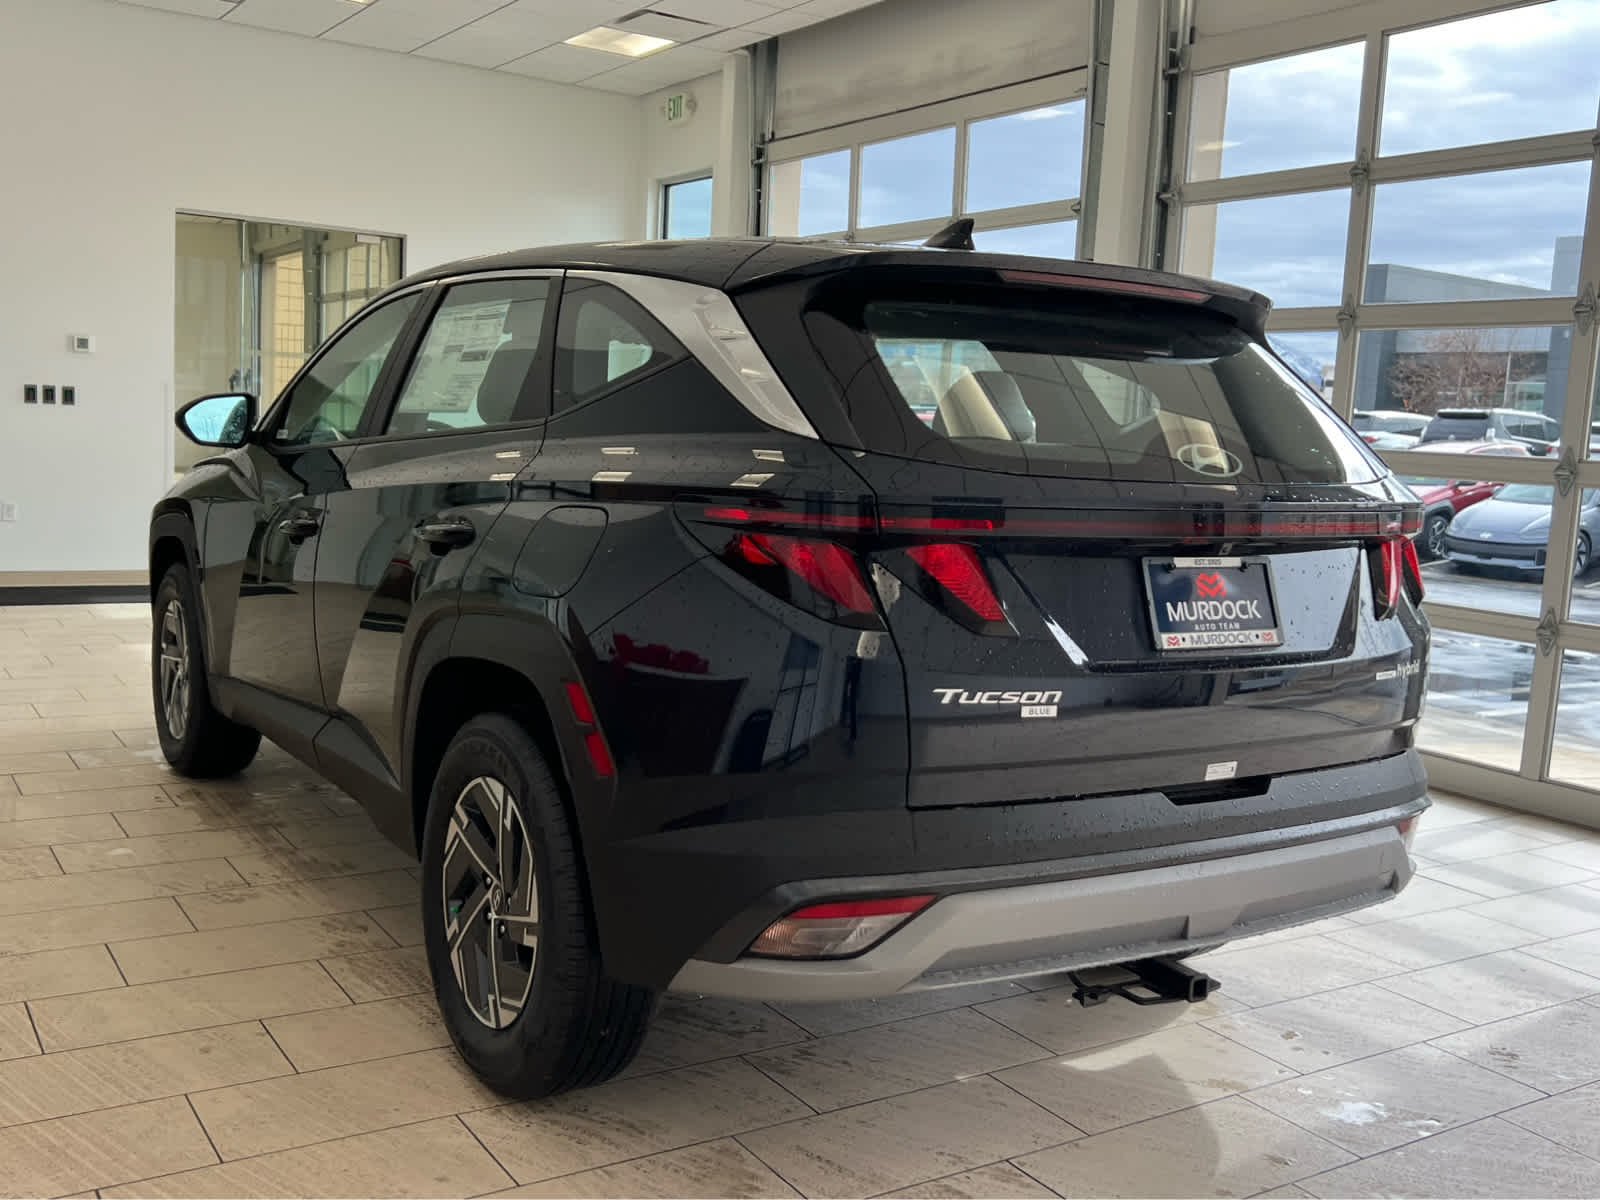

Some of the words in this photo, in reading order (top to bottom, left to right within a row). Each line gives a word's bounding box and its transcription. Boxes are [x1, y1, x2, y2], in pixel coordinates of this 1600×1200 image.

[667, 96, 683, 120] EXIT
[1166, 600, 1262, 622] MURDOCK
[1218, 622, 1240, 630] TEAM
[1189, 631, 1253, 645] MURDOCK
[1028, 707, 1051, 716] BLUE
